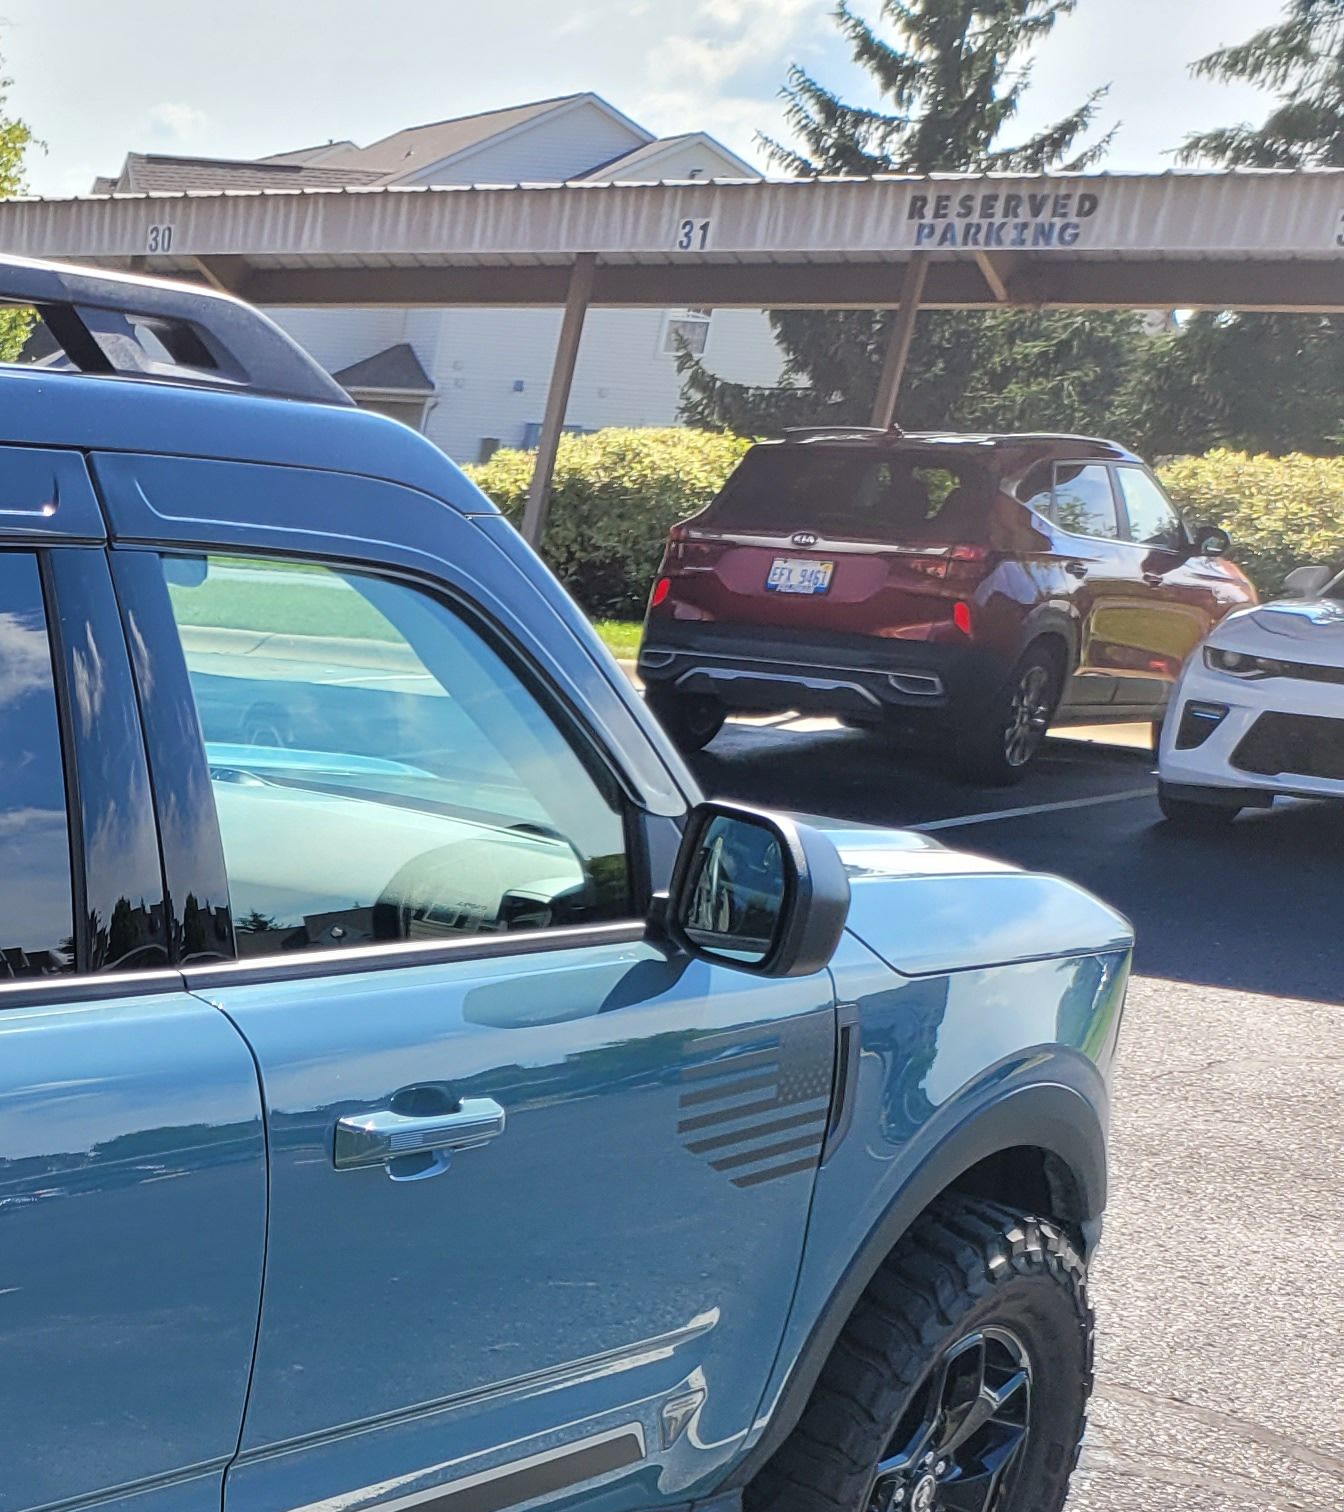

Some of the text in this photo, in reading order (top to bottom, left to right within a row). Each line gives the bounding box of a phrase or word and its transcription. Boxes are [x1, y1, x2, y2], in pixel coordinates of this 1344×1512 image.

[907, 193, 1099, 220] RESERVED
[148, 226, 172, 252] 30
[678, 219, 711, 250] 31
[914, 221, 1080, 247] PARKING
